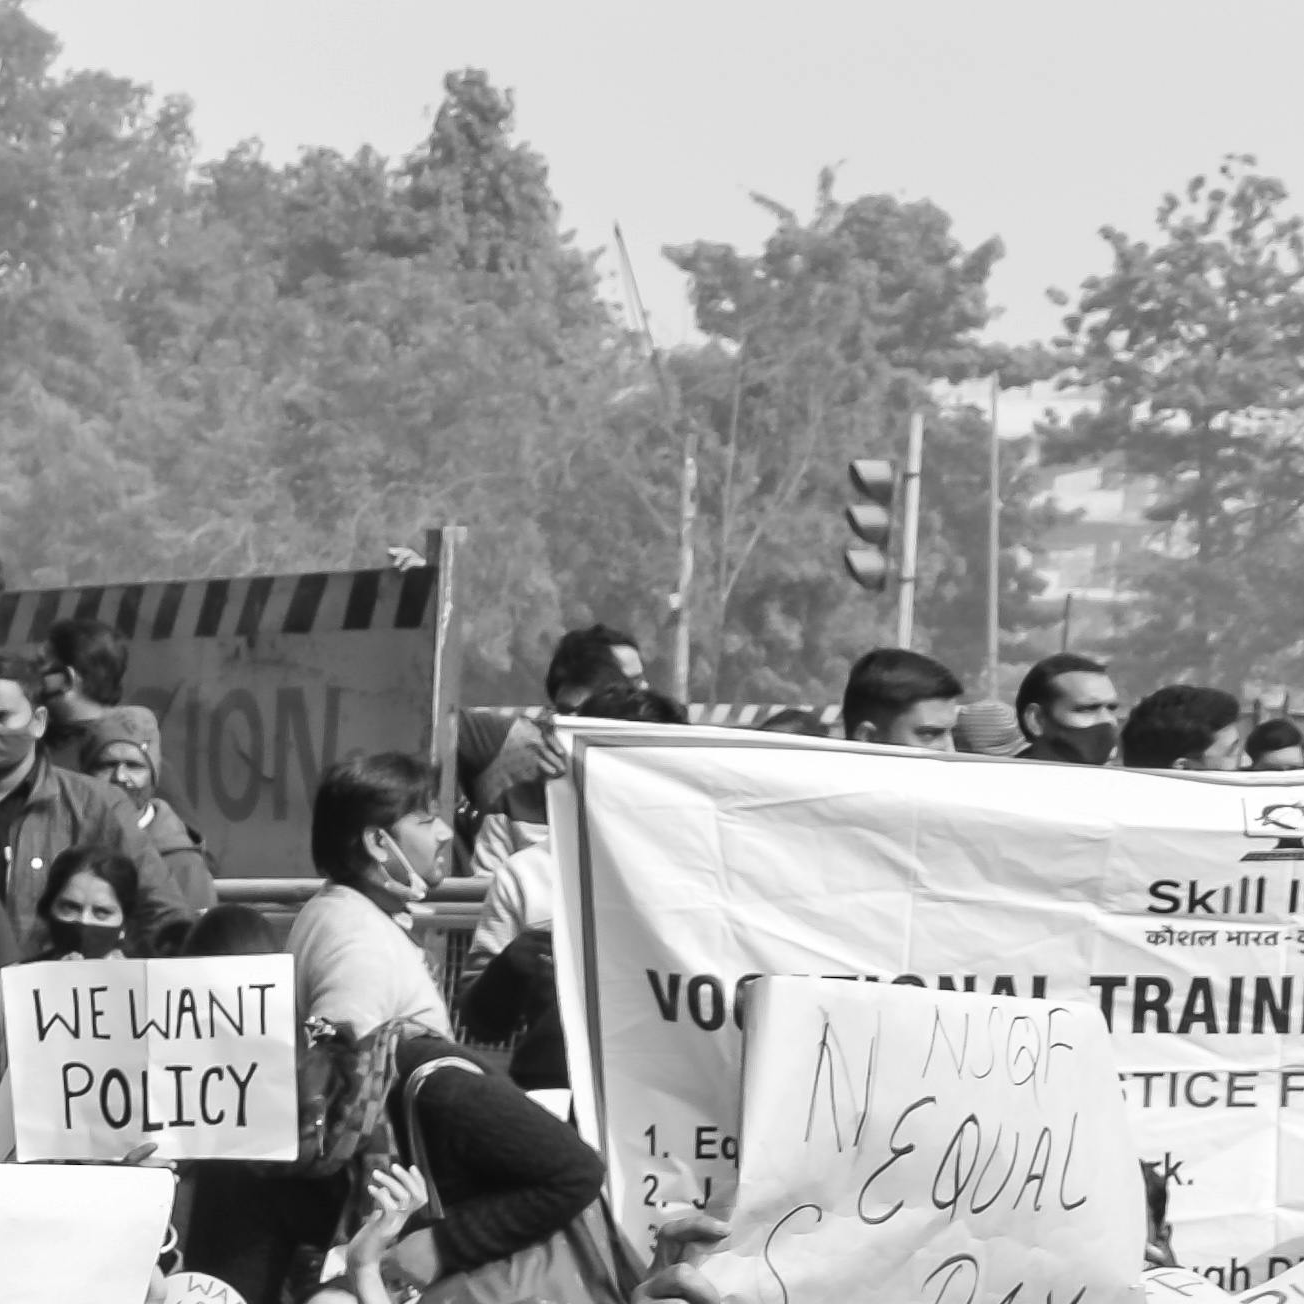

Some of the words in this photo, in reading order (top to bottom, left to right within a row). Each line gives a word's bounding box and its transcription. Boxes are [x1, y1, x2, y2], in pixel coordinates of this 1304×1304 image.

[183, 684, 341, 824] ION
[1147, 876, 1265, 914] Skill
[1288, 879, 1300, 914] I
[1145, 925, 1220, 947] कौशल
[1225, 930, 1281, 947] भारत
[32, 985, 112, 1042] WE
[128, 983, 277, 1041] WANT
[1089, 975, 1304, 1035] TRAIN
[921, 1004, 1074, 1100] NSQF
[61, 1060, 259, 1133] POLICY
[1119, 1071, 1259, 1109] TICE
[644, 1124, 669, 1158] 1.
[695, 1125, 738, 1169] Eq
[858, 1095, 1088, 1226] EQUAL
[643, 1174, 668, 1209] 2.
